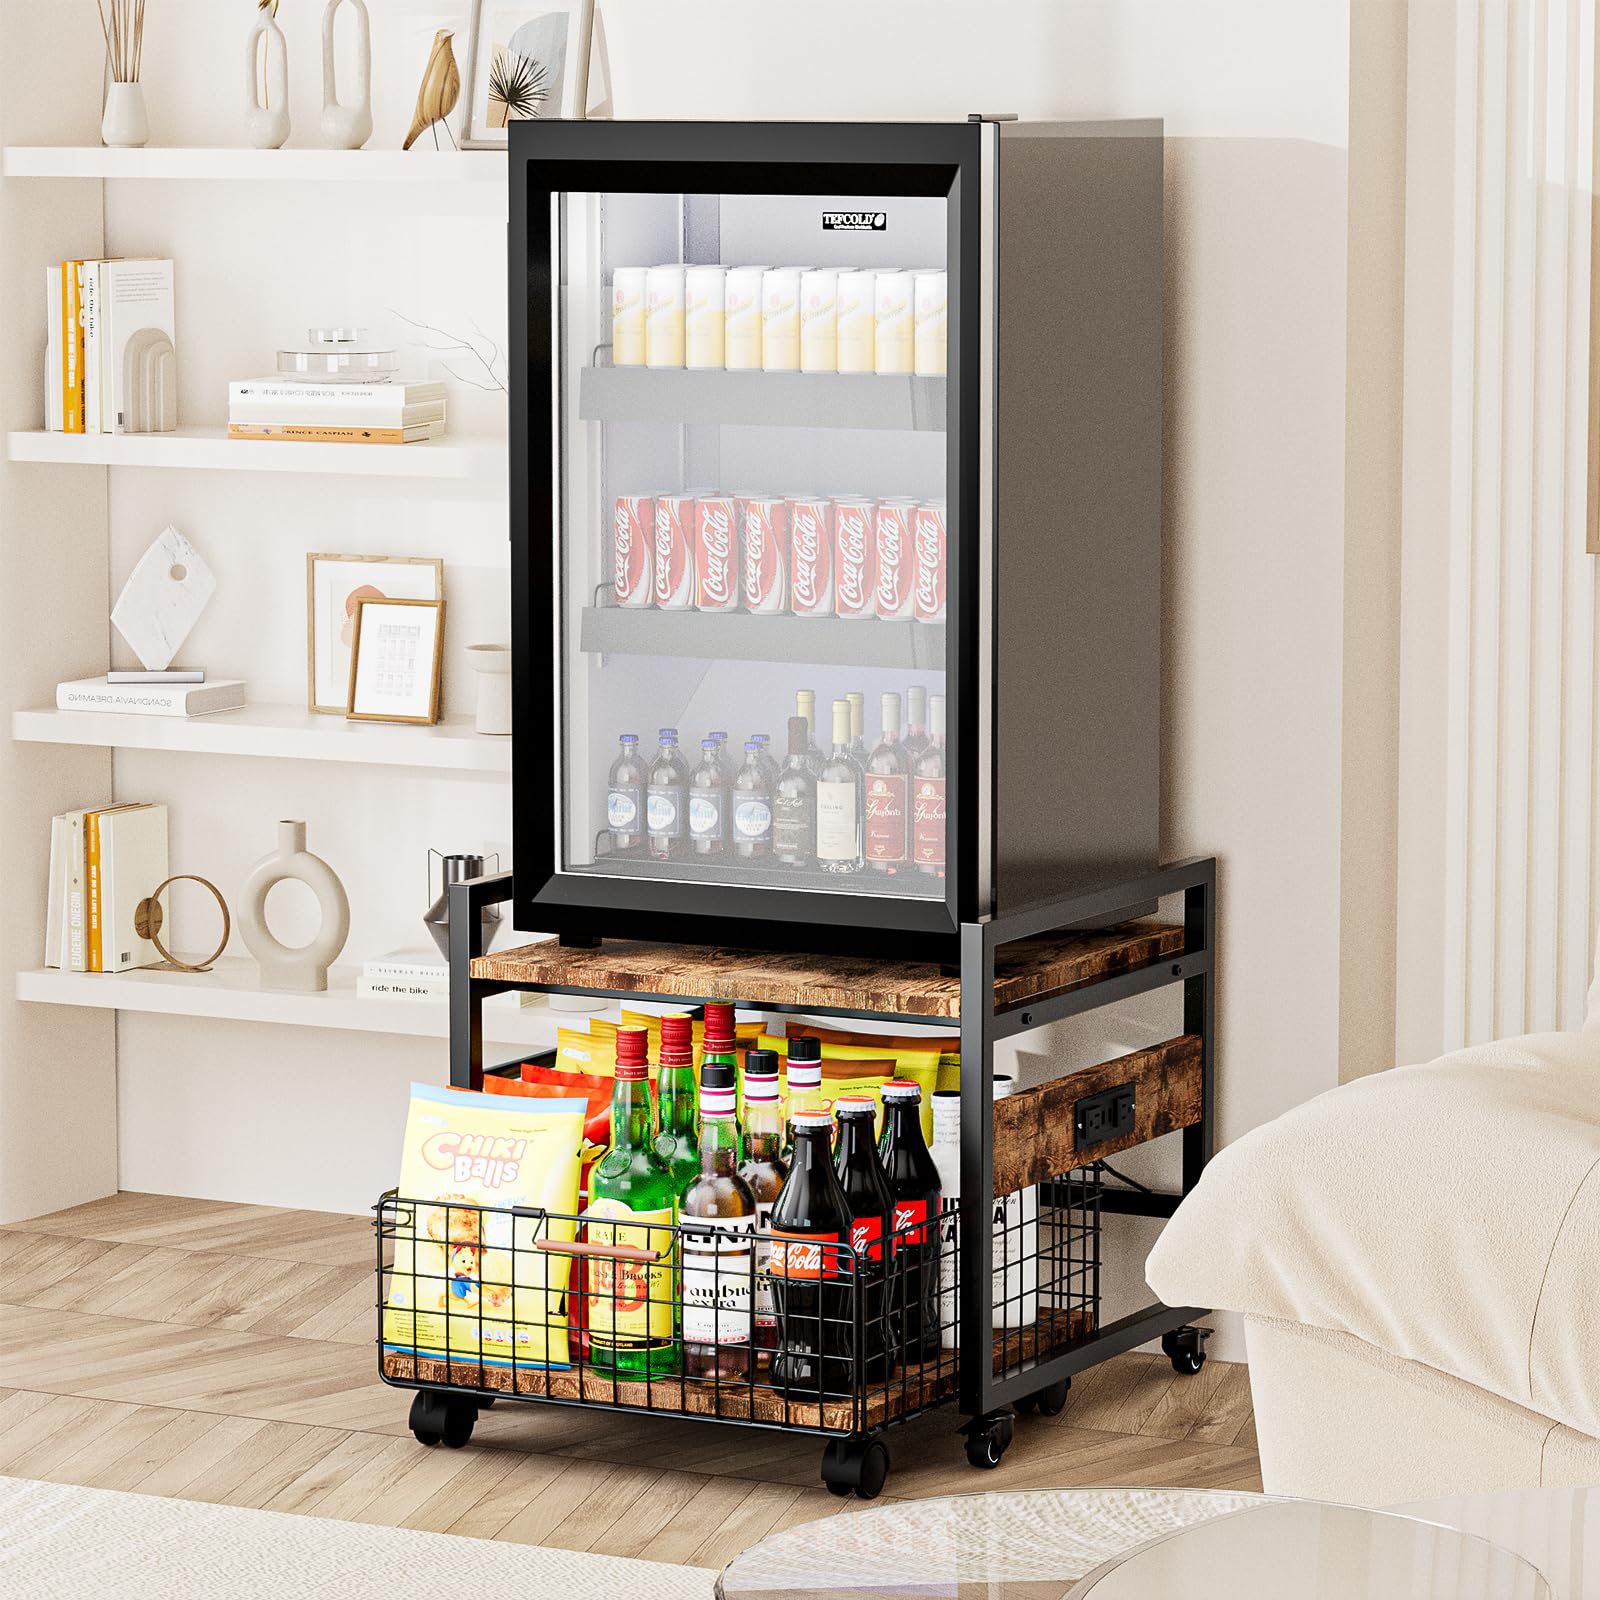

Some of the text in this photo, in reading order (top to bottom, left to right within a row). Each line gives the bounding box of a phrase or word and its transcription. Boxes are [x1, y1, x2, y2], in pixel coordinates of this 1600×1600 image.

[823, 213, 873, 225] TEFCOLD
[371, 984, 390, 992] ride
[421, 1131, 528, 1171] CHIKI
[454, 1154, 520, 1189] Balls
